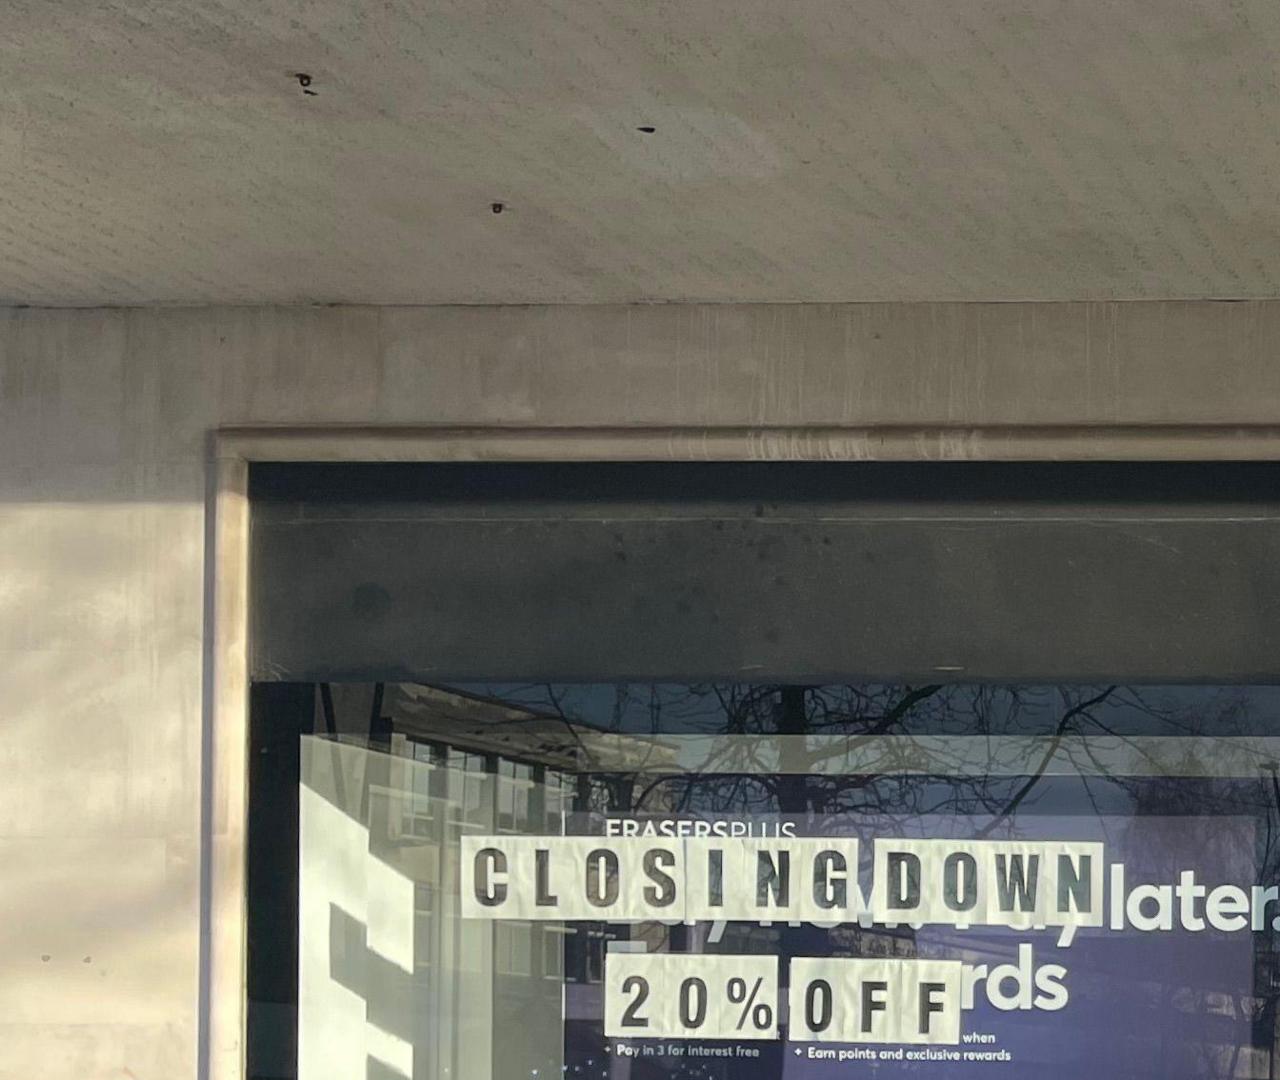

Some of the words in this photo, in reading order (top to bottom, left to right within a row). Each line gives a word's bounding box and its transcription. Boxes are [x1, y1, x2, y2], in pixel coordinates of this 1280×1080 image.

[473, 847, 848, 910] CLOSING
[886, 851, 1092, 914] DOWN
[620, 976, 773, 1031] 20%
[804, 978, 946, 1034] OFF
[963, 1032, 996, 1043] when
[617, 1044, 640, 1058] Pay
[643, 1044, 654, 1056] in
[658, 1045, 665, 1056] 3
[668, 1044, 684, 1056] for
[688, 1045, 732, 1057] interest
[736, 1045, 760, 1057] free
[808, 1047, 835, 1059] Earn
[839, 1047, 876, 1061] points
[880, 1048, 903, 1060] and
[906, 1048, 960, 1061] exclusive
[963, 1049, 1012, 1061] rewards
